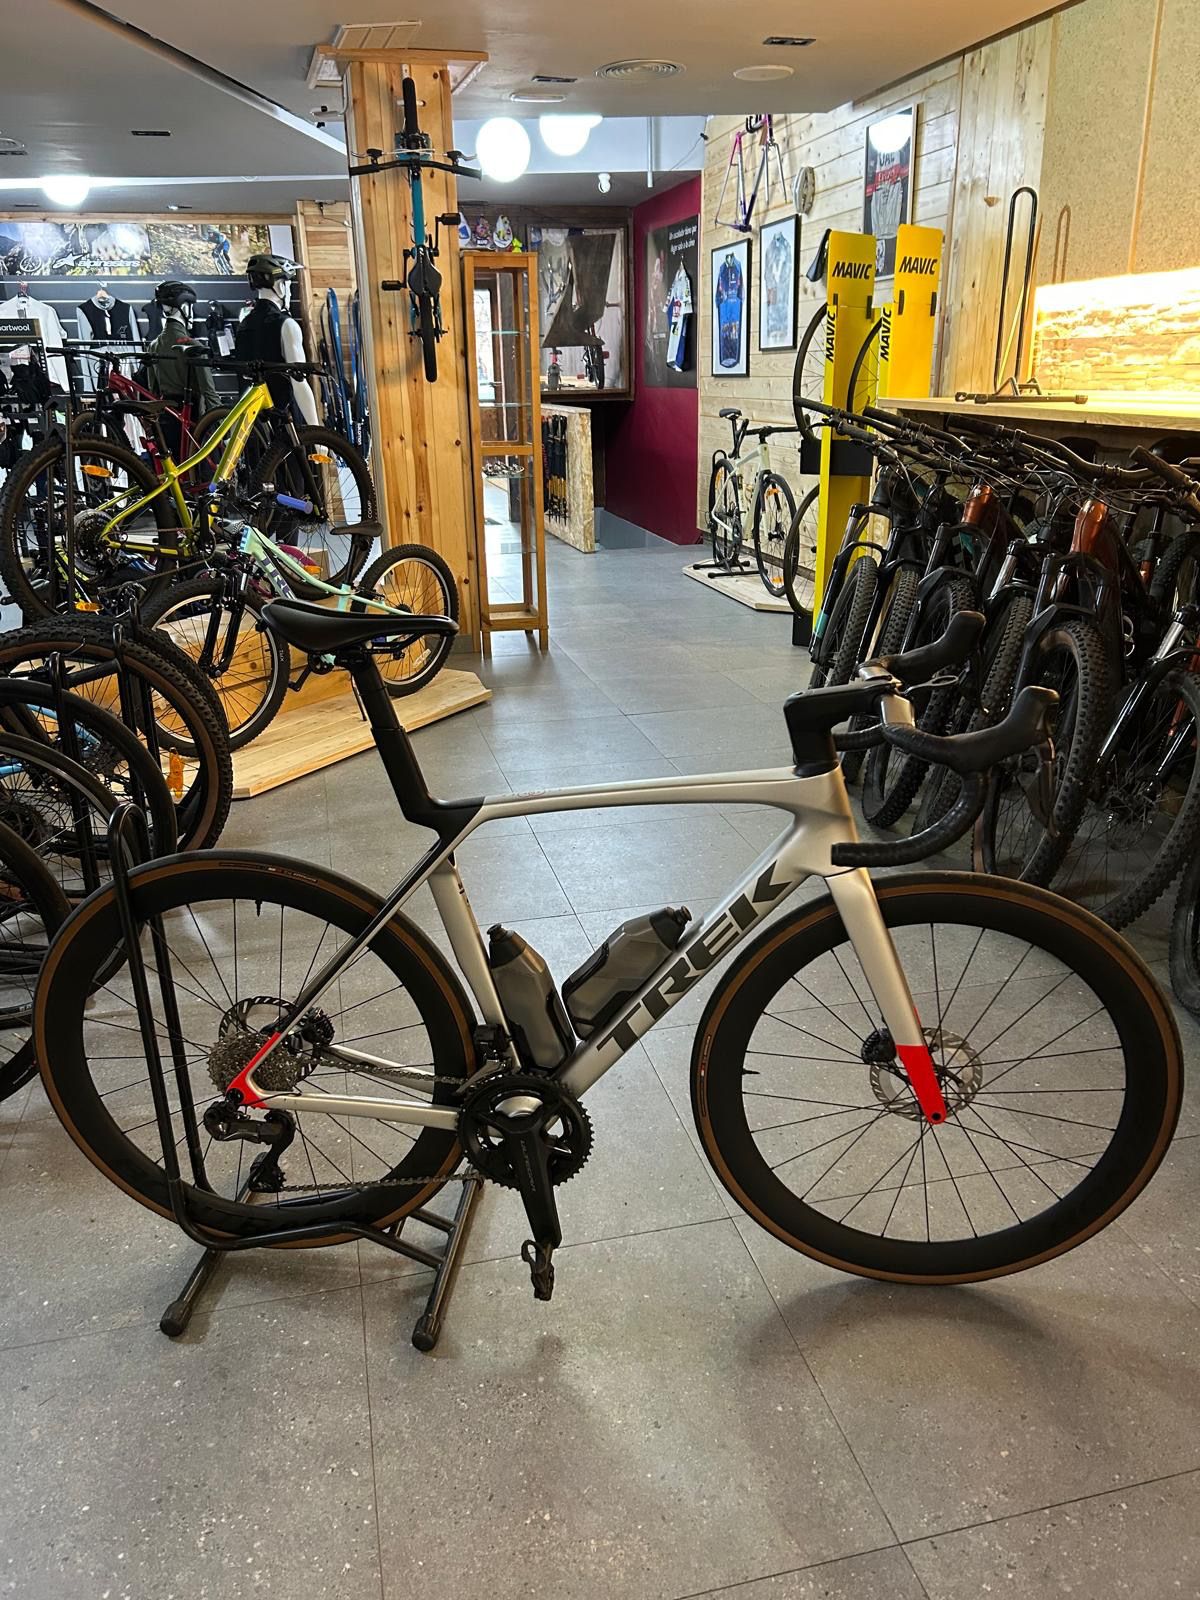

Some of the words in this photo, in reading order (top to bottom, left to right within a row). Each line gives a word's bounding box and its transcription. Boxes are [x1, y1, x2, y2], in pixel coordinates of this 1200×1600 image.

[832, 261, 873, 280] MAVIC
[899, 256, 938, 275] MAVIC
[0, 324, 31, 332] artwool
[825, 311, 836, 363] MAVIC
[880, 307, 892, 362] MAVIC
[596, 859, 793, 1053] TREK
